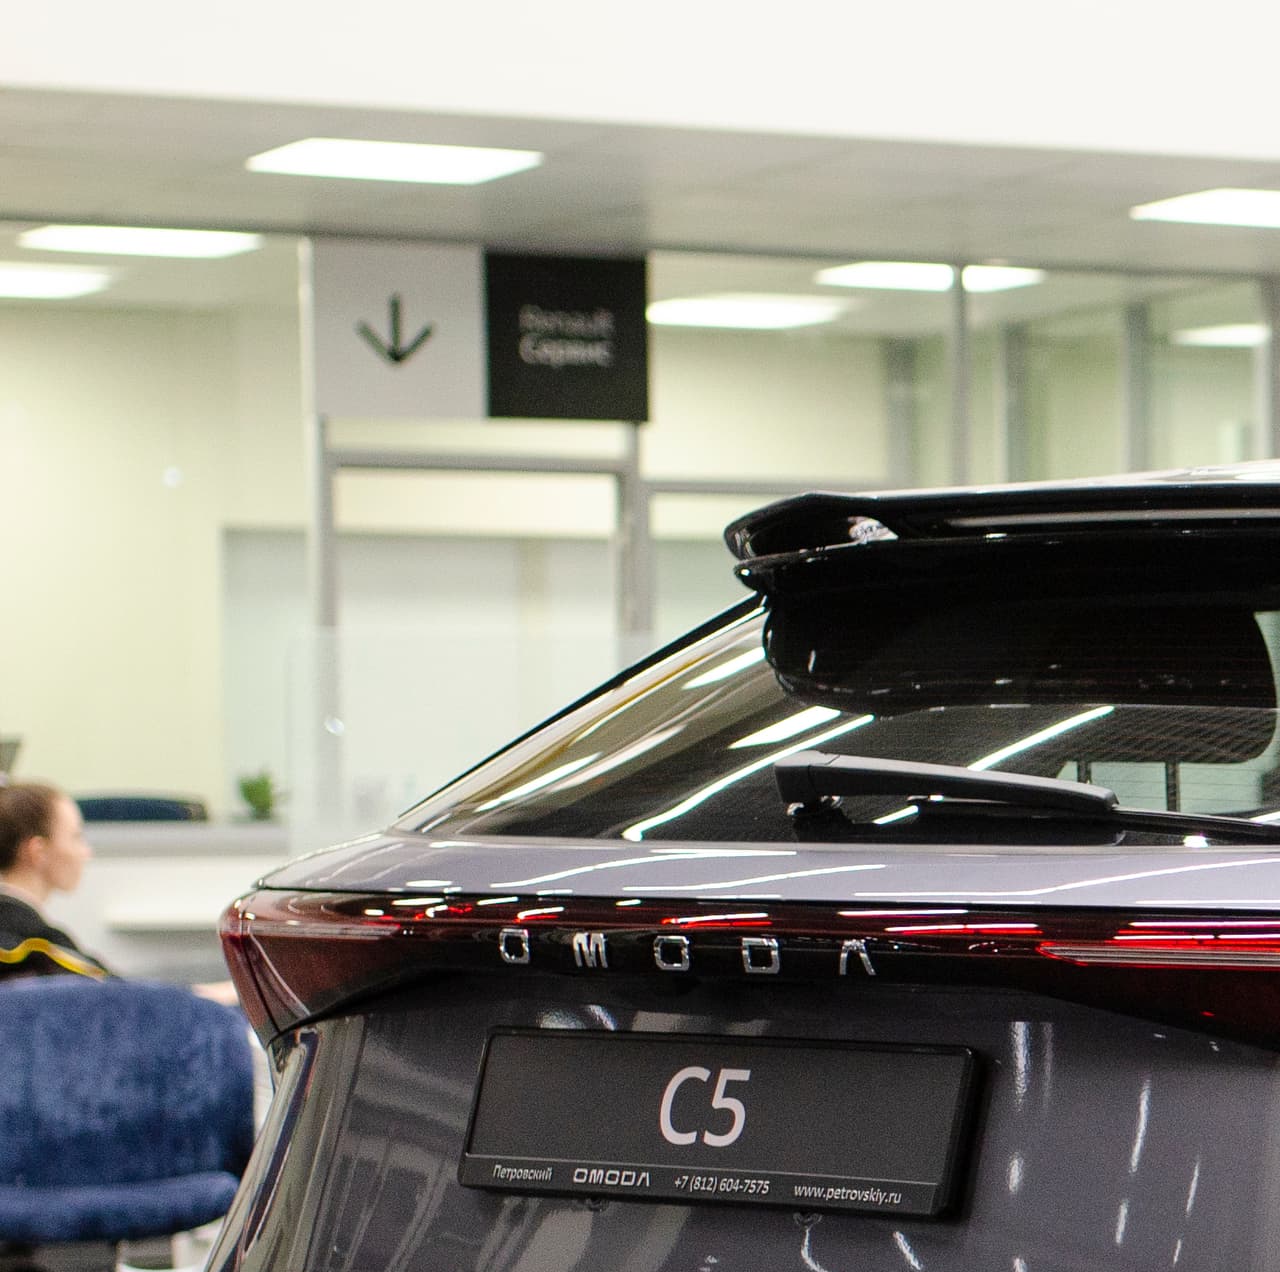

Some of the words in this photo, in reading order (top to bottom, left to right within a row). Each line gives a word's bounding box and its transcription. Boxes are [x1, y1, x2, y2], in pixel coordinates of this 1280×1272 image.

[659, 1066, 751, 1147] C5
[492, 1164, 553, 1181] Петровский
[573, 1168, 651, 1187] OMODA
[674, 1175, 688, 1189] +7
[690, 1176, 717, 1193] (812)
[719, 1178, 770, 1194] 604-7575
[794, 1183, 902, 1205] www.petrovskiy.ru
